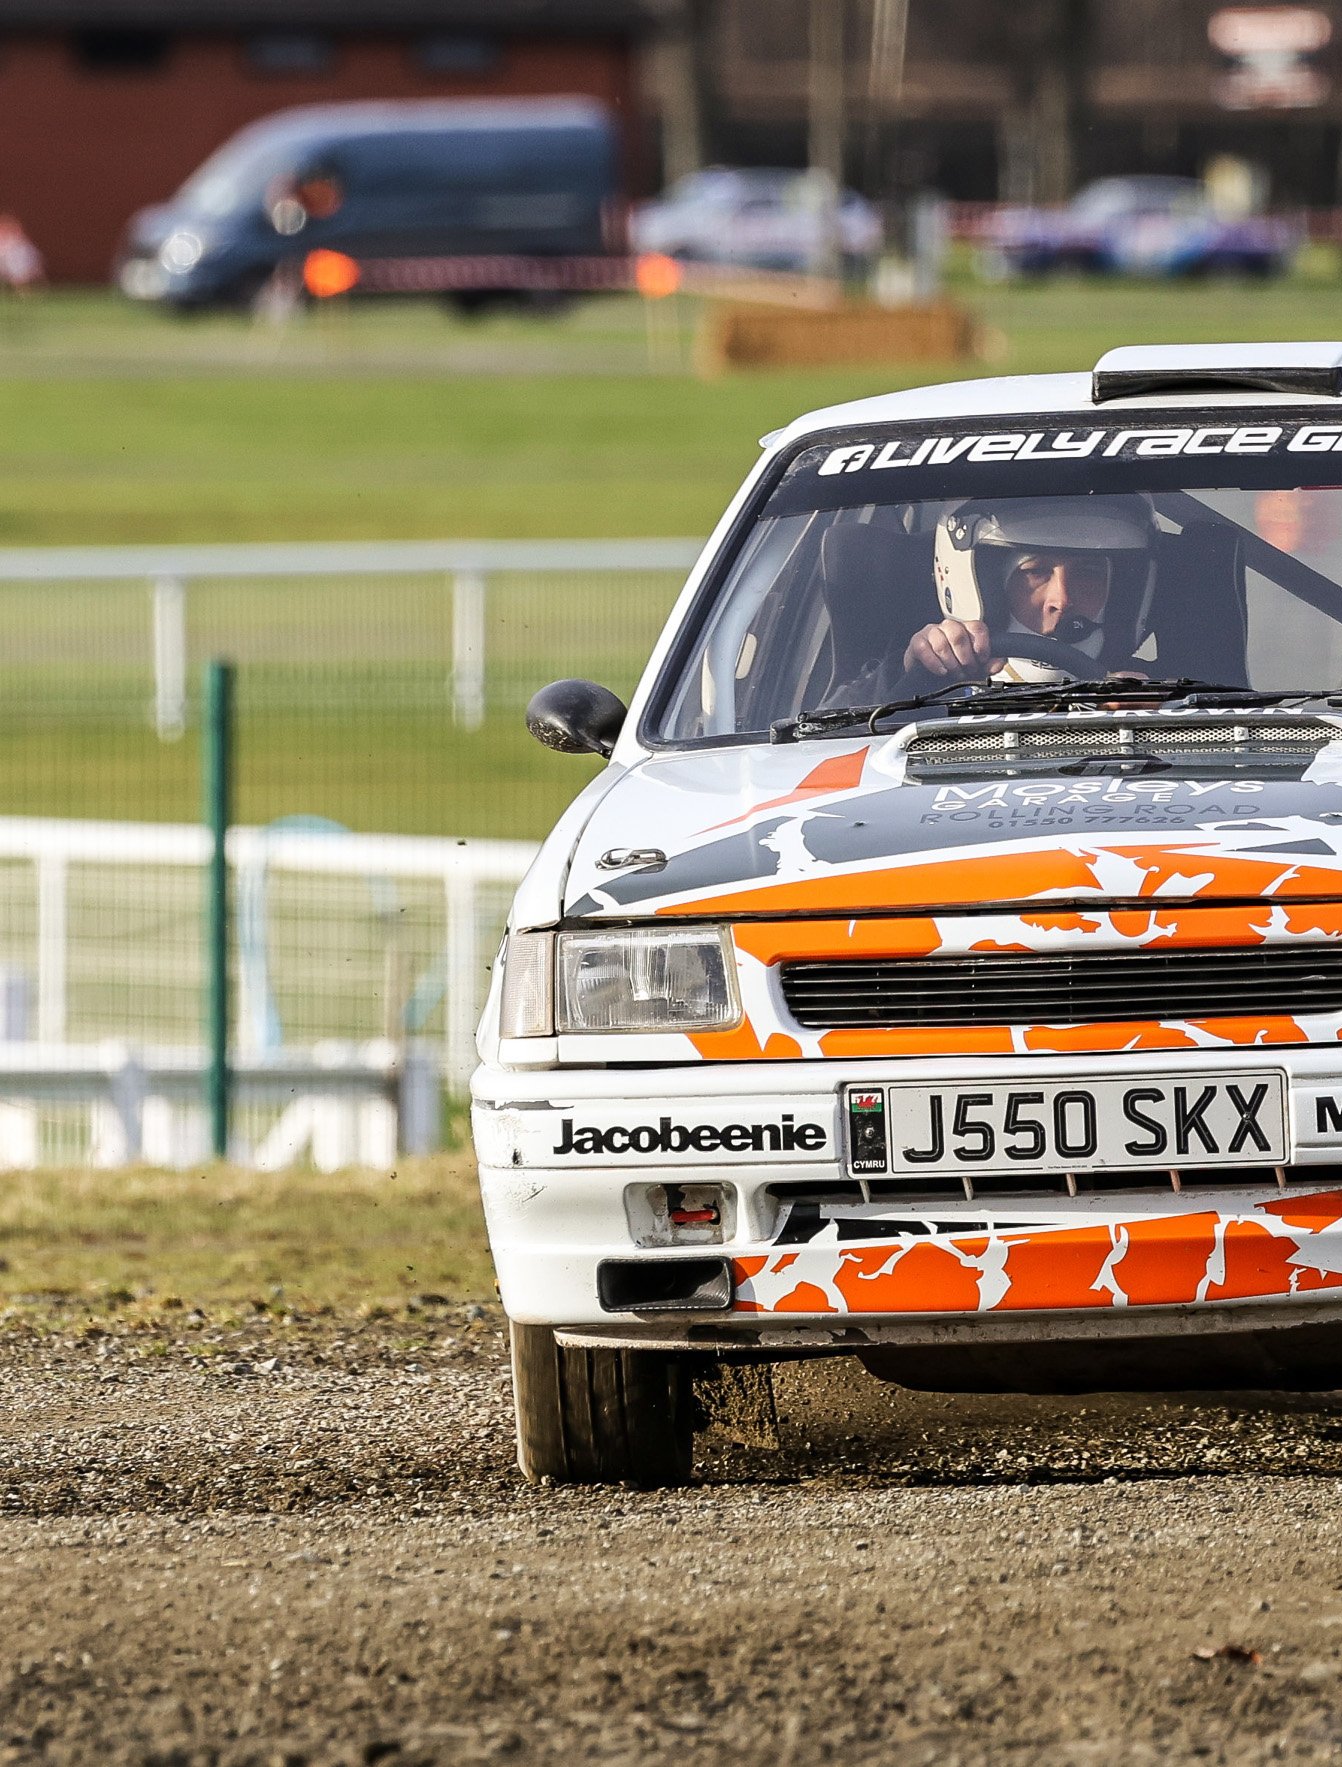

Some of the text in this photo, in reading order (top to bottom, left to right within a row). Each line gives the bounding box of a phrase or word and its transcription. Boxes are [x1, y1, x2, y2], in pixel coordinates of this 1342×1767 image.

[934, 778, 1266, 802] Mosleys
[931, 792, 1174, 811] GARAGE
[919, 804, 1261, 824] ROLLING ROAD
[988, 816, 1186, 829] 01550 777626
[902, 1083, 1272, 1164] J550 SKX
[553, 1114, 827, 1155] Jacobeenie
[853, 1160, 885, 1169] CYMRU
